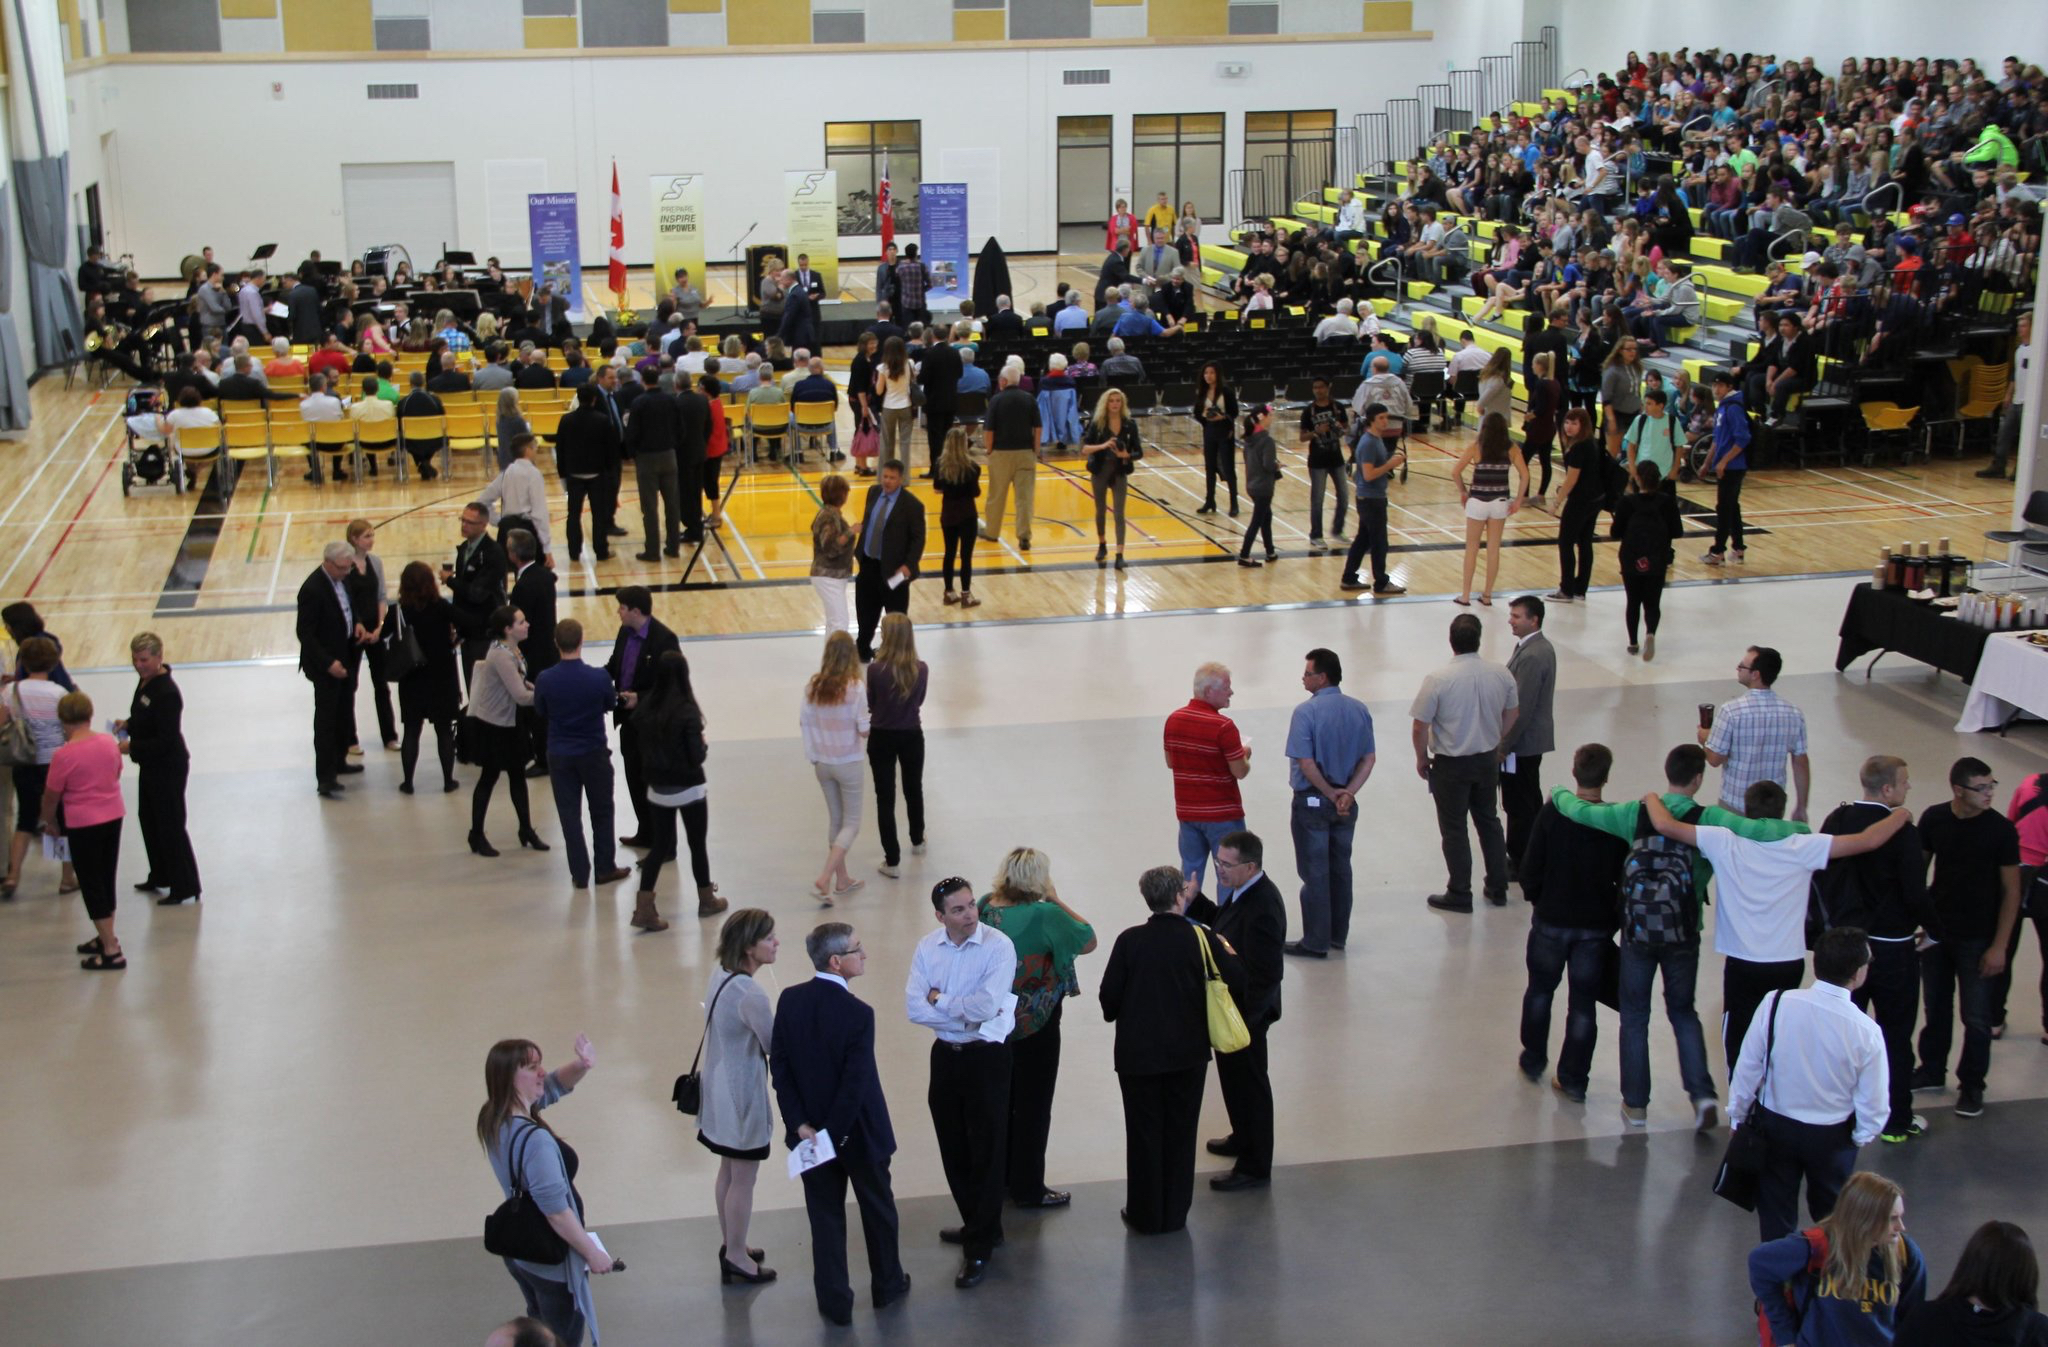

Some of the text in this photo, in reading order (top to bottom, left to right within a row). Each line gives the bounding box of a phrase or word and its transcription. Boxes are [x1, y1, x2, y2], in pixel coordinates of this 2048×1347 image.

[922, 186, 966, 195] We Believe
[530, 195, 577, 206] Our Mission
[661, 205, 695, 213] PREPARE
[660, 214, 697, 224] INSPIRE
[660, 223, 697, 233] EMPOWER
